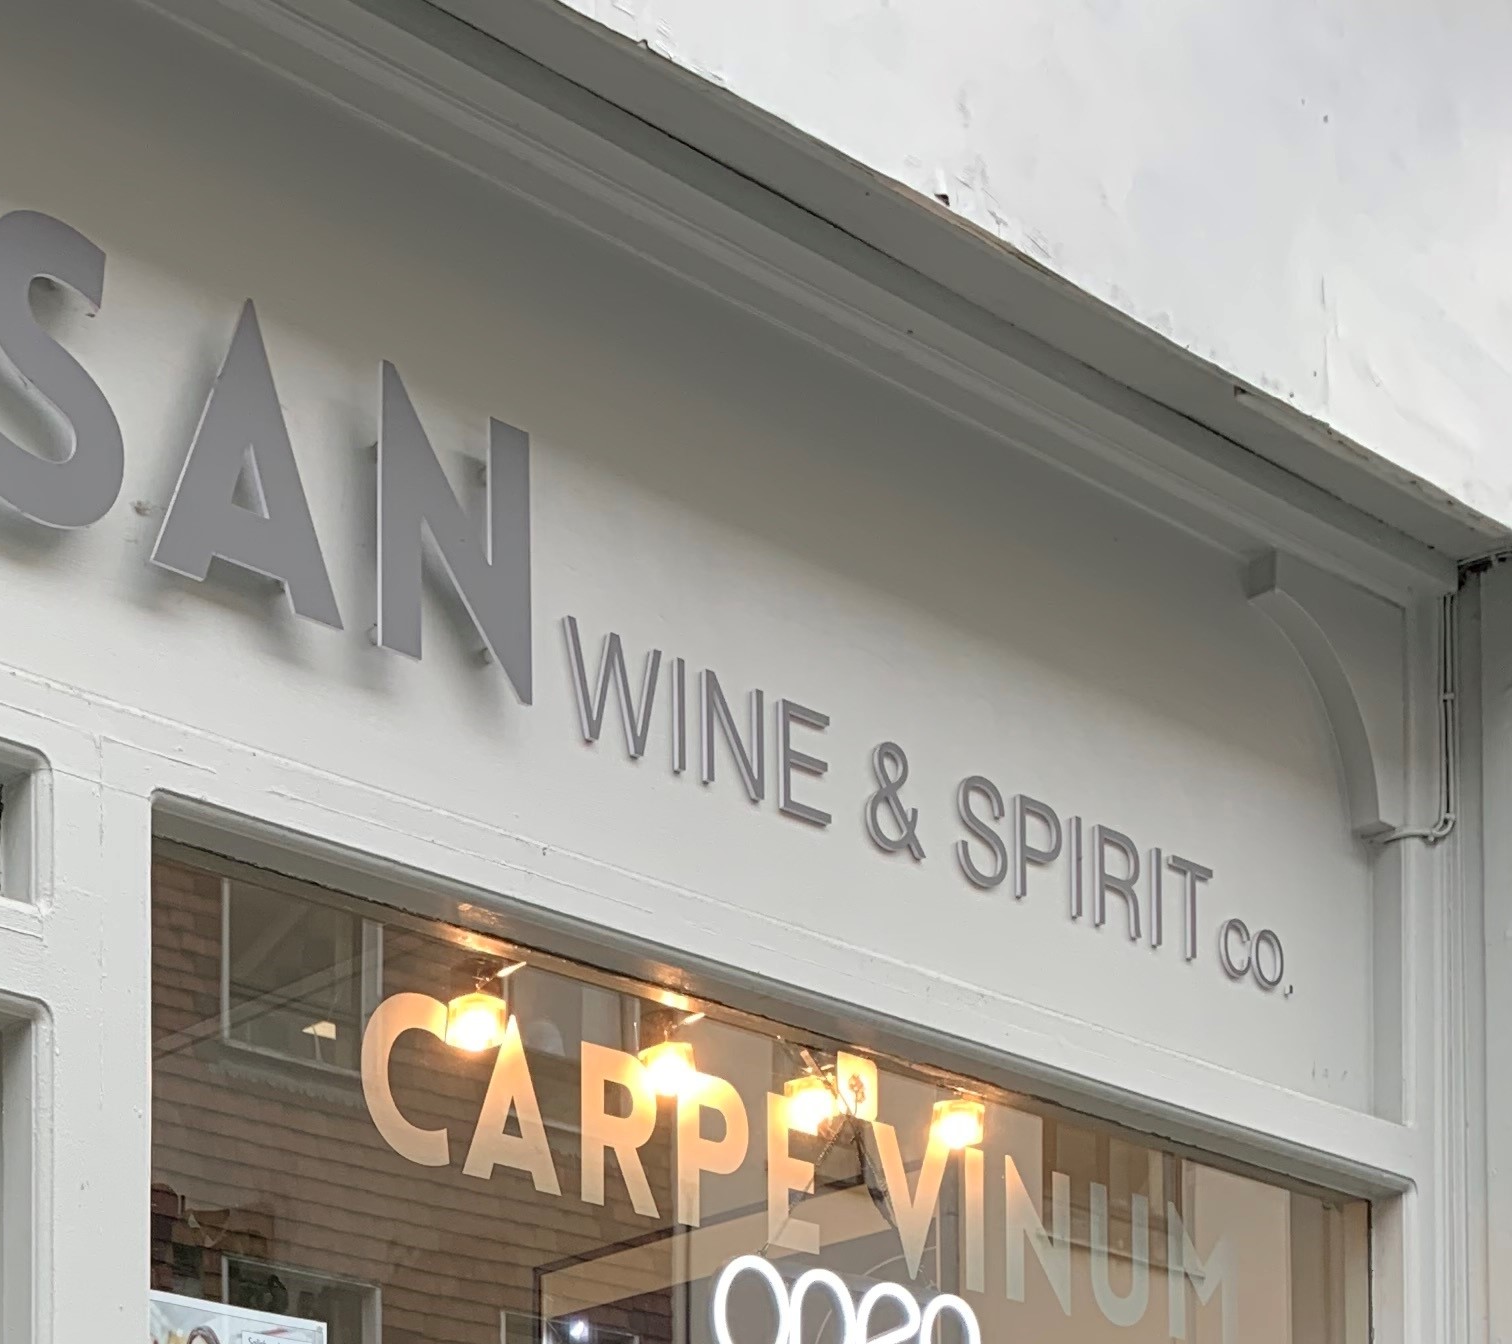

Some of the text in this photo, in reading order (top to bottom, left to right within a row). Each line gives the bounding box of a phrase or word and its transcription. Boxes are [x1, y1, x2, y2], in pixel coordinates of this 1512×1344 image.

[562, 615, 832, 827] WINE
[866, 740, 926, 861] &
[957, 775, 1214, 962] SPIRIT
[360, 992, 821, 1256] CARPE
